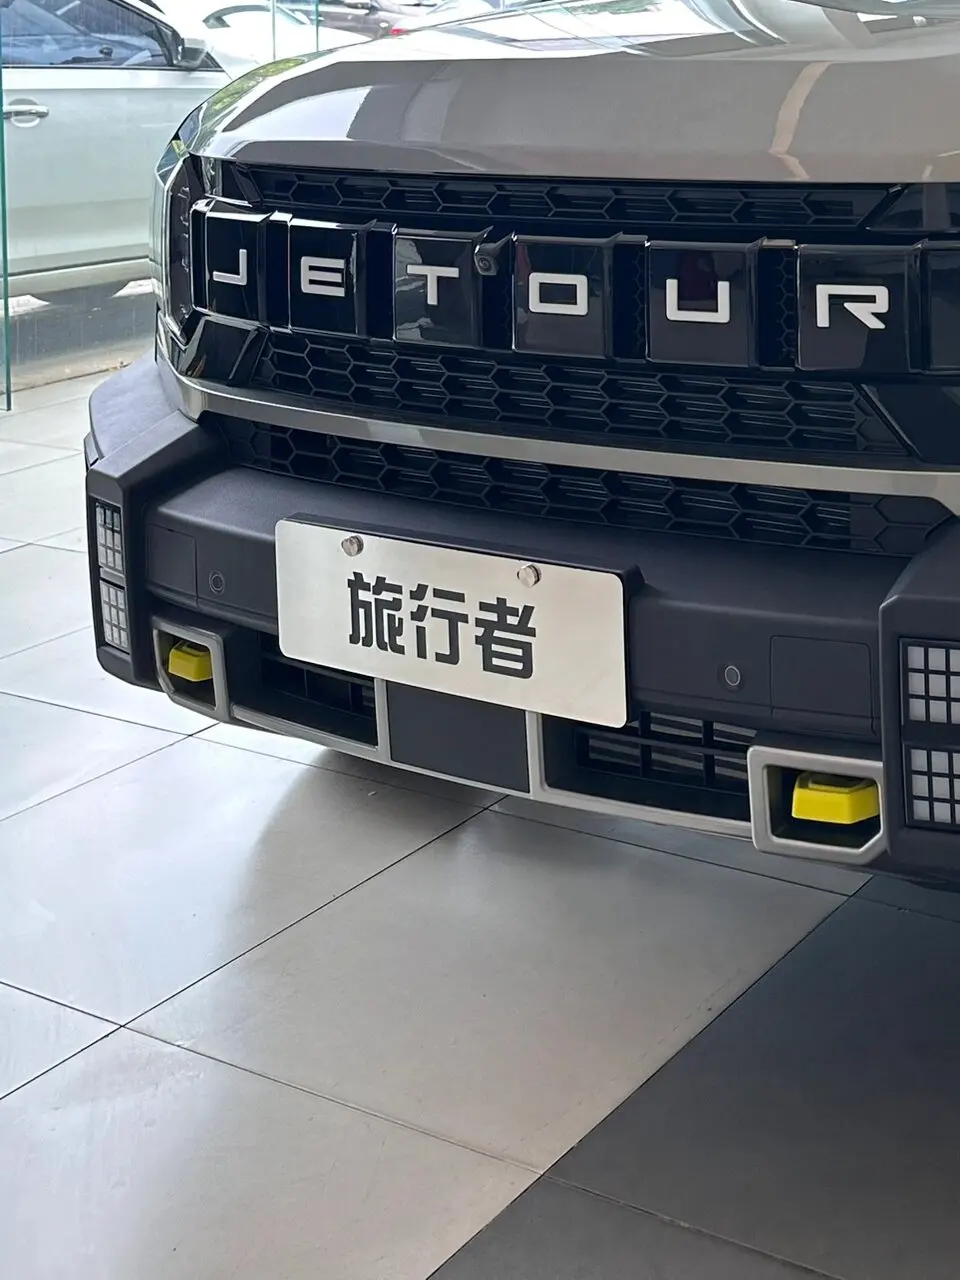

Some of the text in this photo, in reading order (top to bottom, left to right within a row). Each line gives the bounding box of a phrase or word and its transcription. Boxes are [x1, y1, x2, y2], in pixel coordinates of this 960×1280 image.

[212, 248, 890, 330] JETOUR
[346, 571, 537, 680] 旅行者
